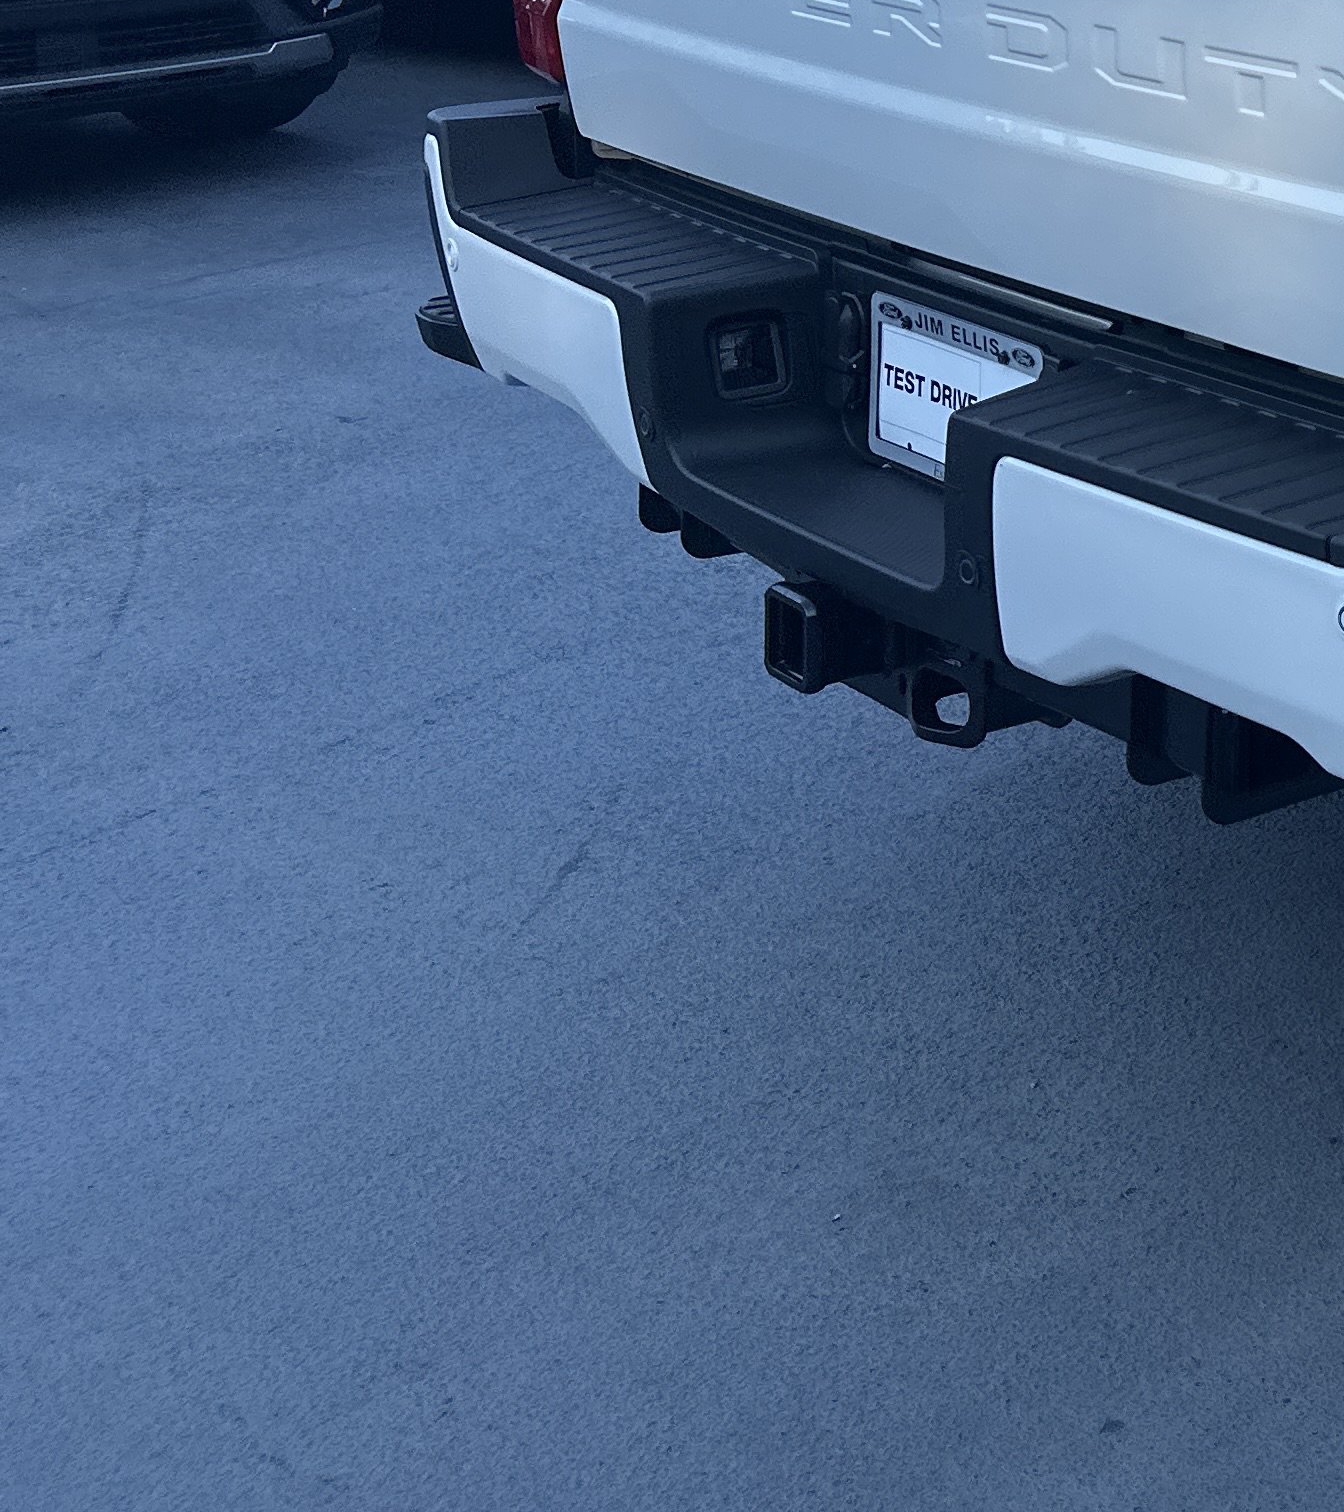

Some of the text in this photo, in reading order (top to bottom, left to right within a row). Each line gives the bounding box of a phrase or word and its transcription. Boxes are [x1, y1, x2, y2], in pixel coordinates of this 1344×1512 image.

[914, 312, 1000, 355] JIM ELLIS
[884, 363, 926, 397] TEST
